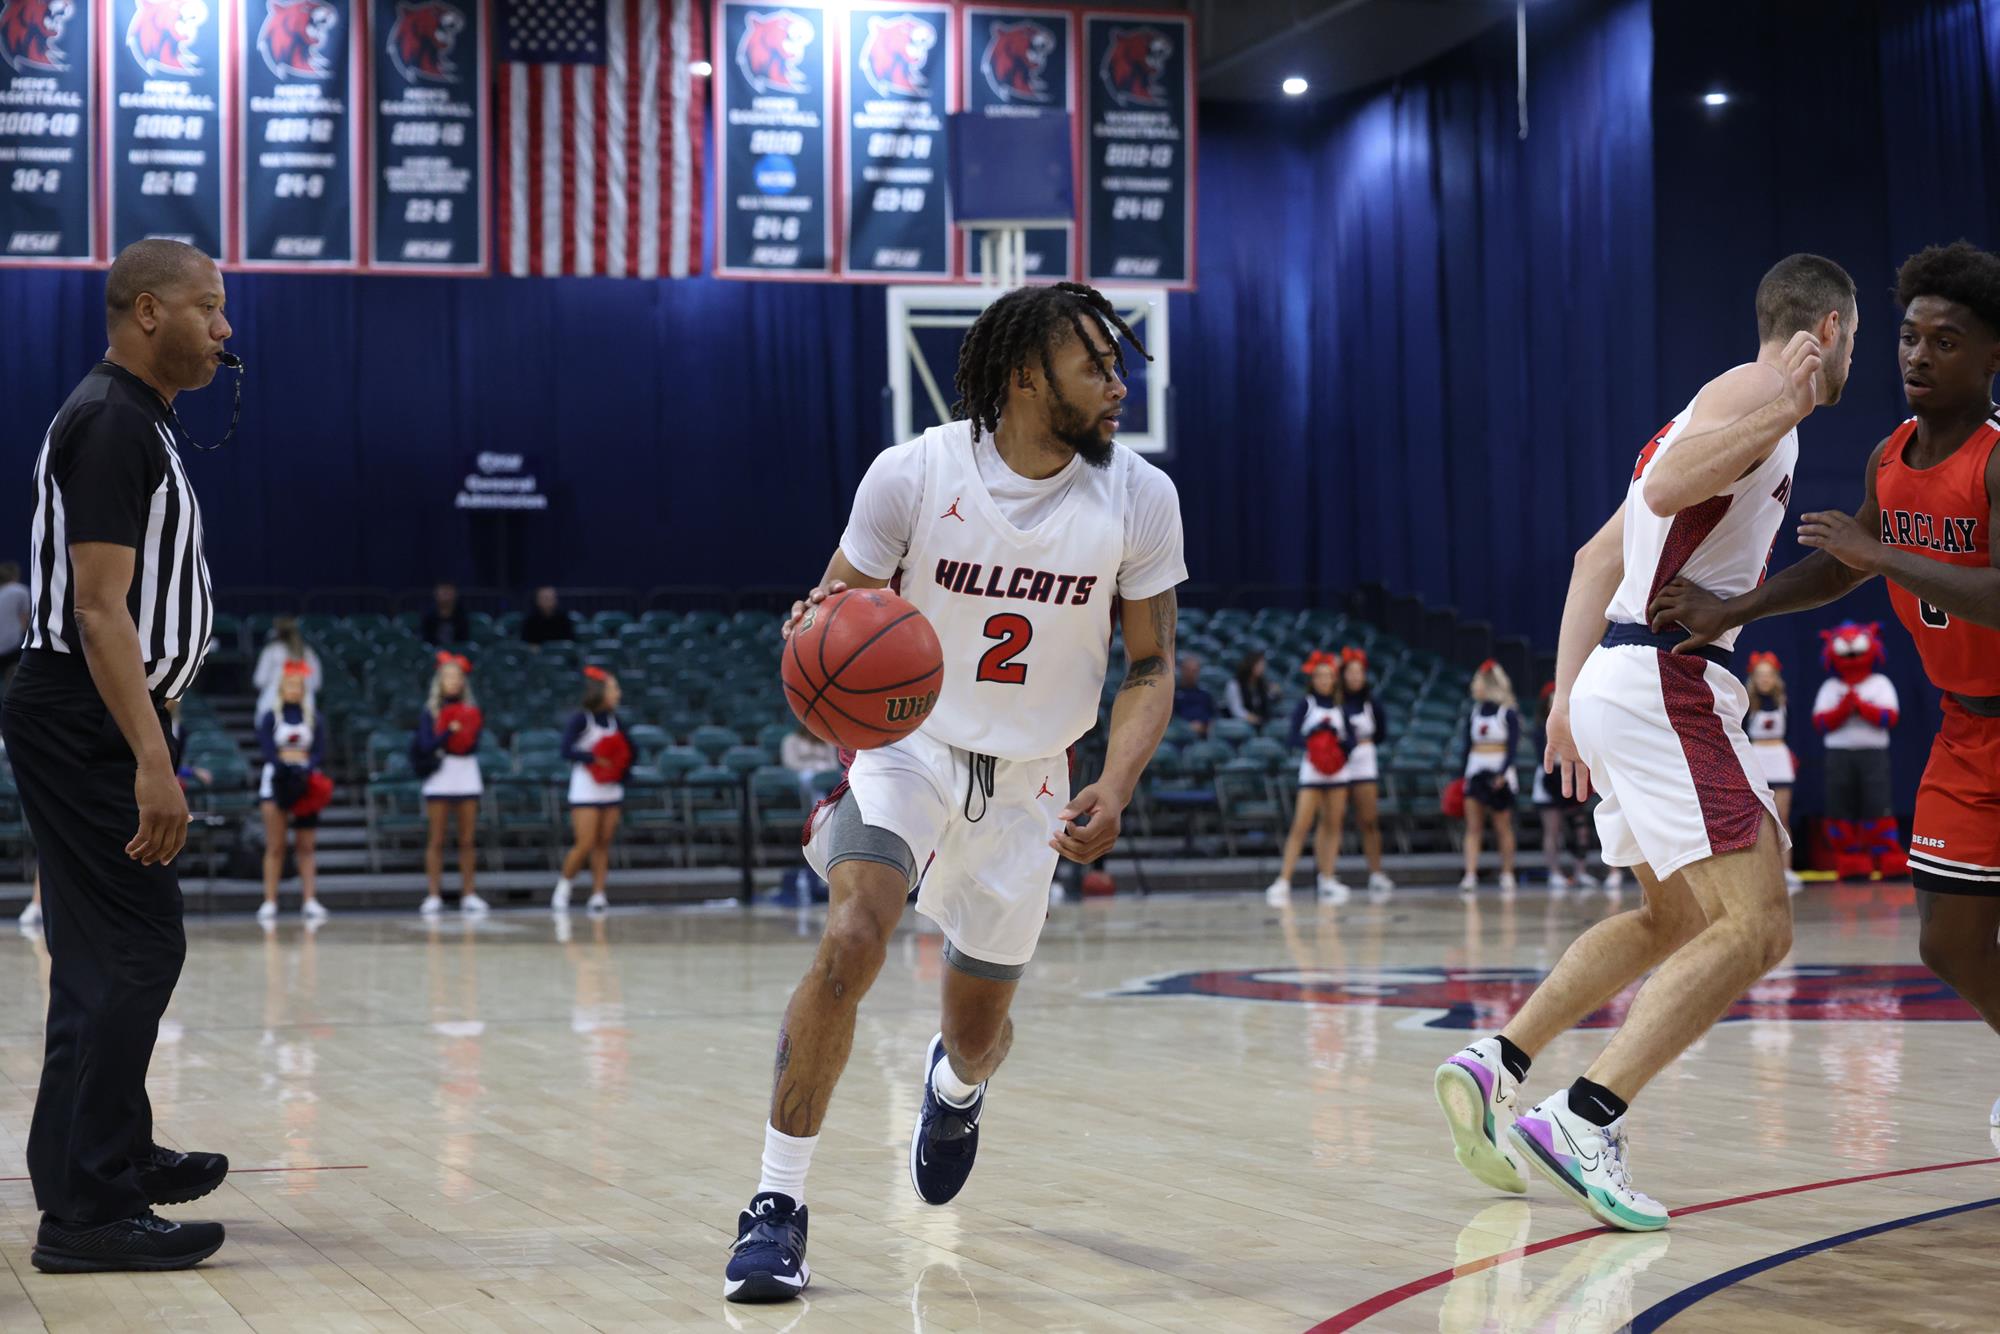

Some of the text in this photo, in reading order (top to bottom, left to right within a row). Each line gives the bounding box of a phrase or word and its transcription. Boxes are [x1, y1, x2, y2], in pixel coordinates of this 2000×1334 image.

[935, 558, 1098, 606] HILLCATS
[976, 612, 1033, 685] 2
[1912, 833, 1946, 849] BEARS
